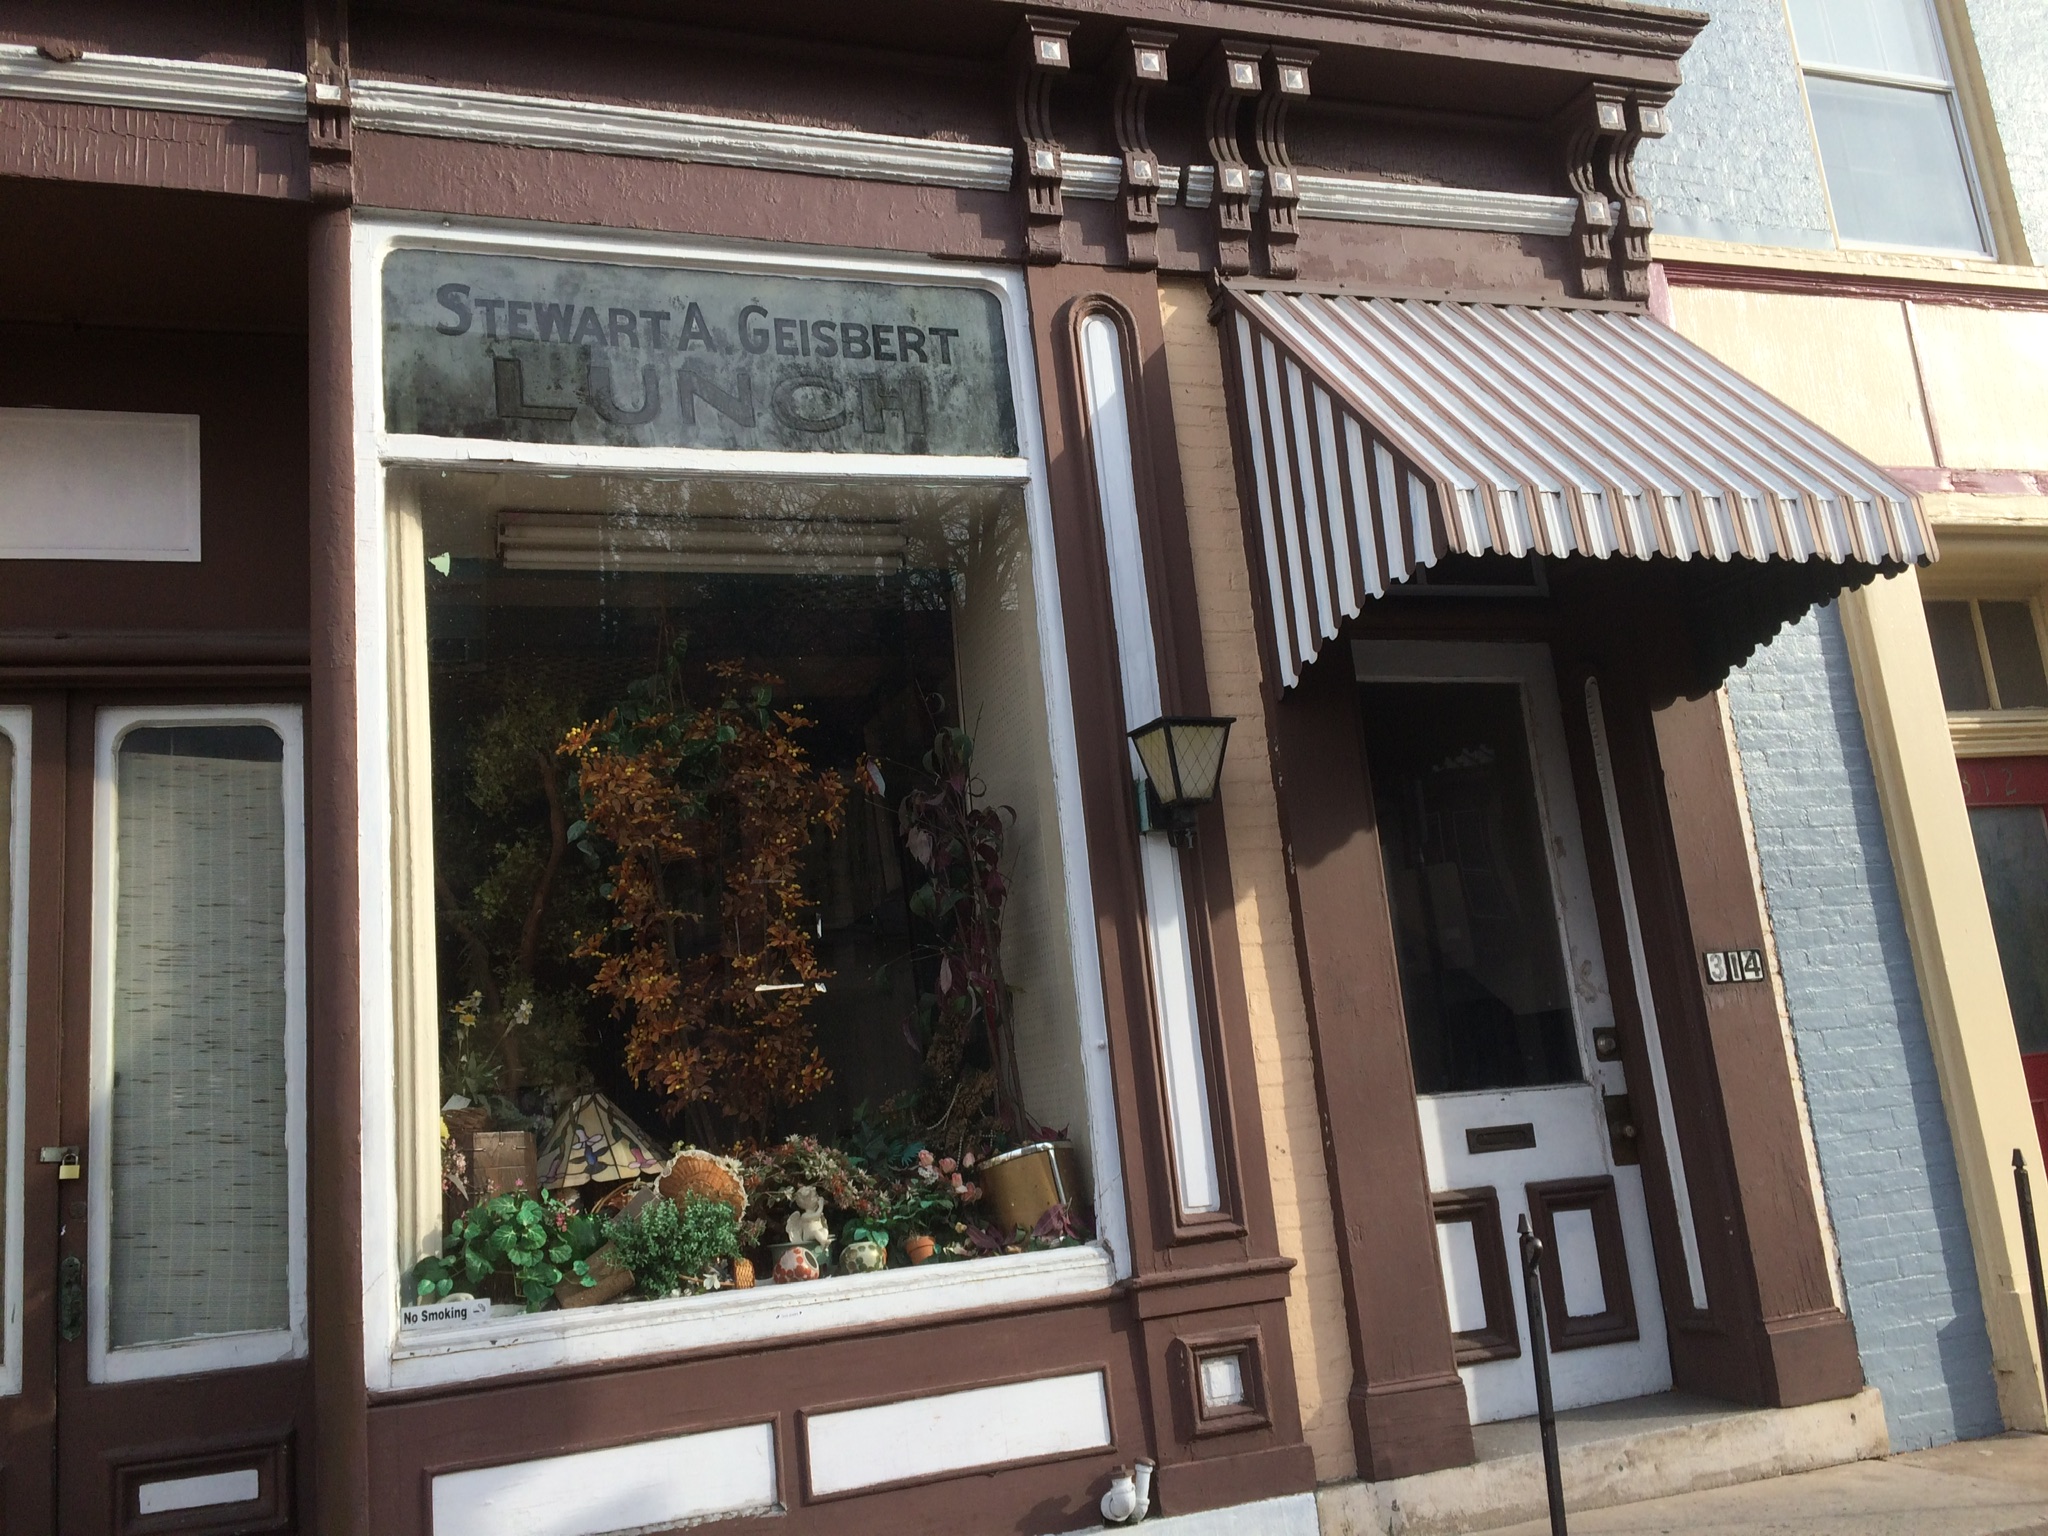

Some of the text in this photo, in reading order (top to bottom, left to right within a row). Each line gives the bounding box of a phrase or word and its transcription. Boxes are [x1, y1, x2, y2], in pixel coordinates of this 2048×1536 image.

[436, 282, 672, 351] STEWART
[738, 304, 960, 364] GEISBERT
[493, 356, 927, 435] LUNCH
[1708, 951, 1761, 980] 314
[403, 1307, 467, 1325] No Smoking
